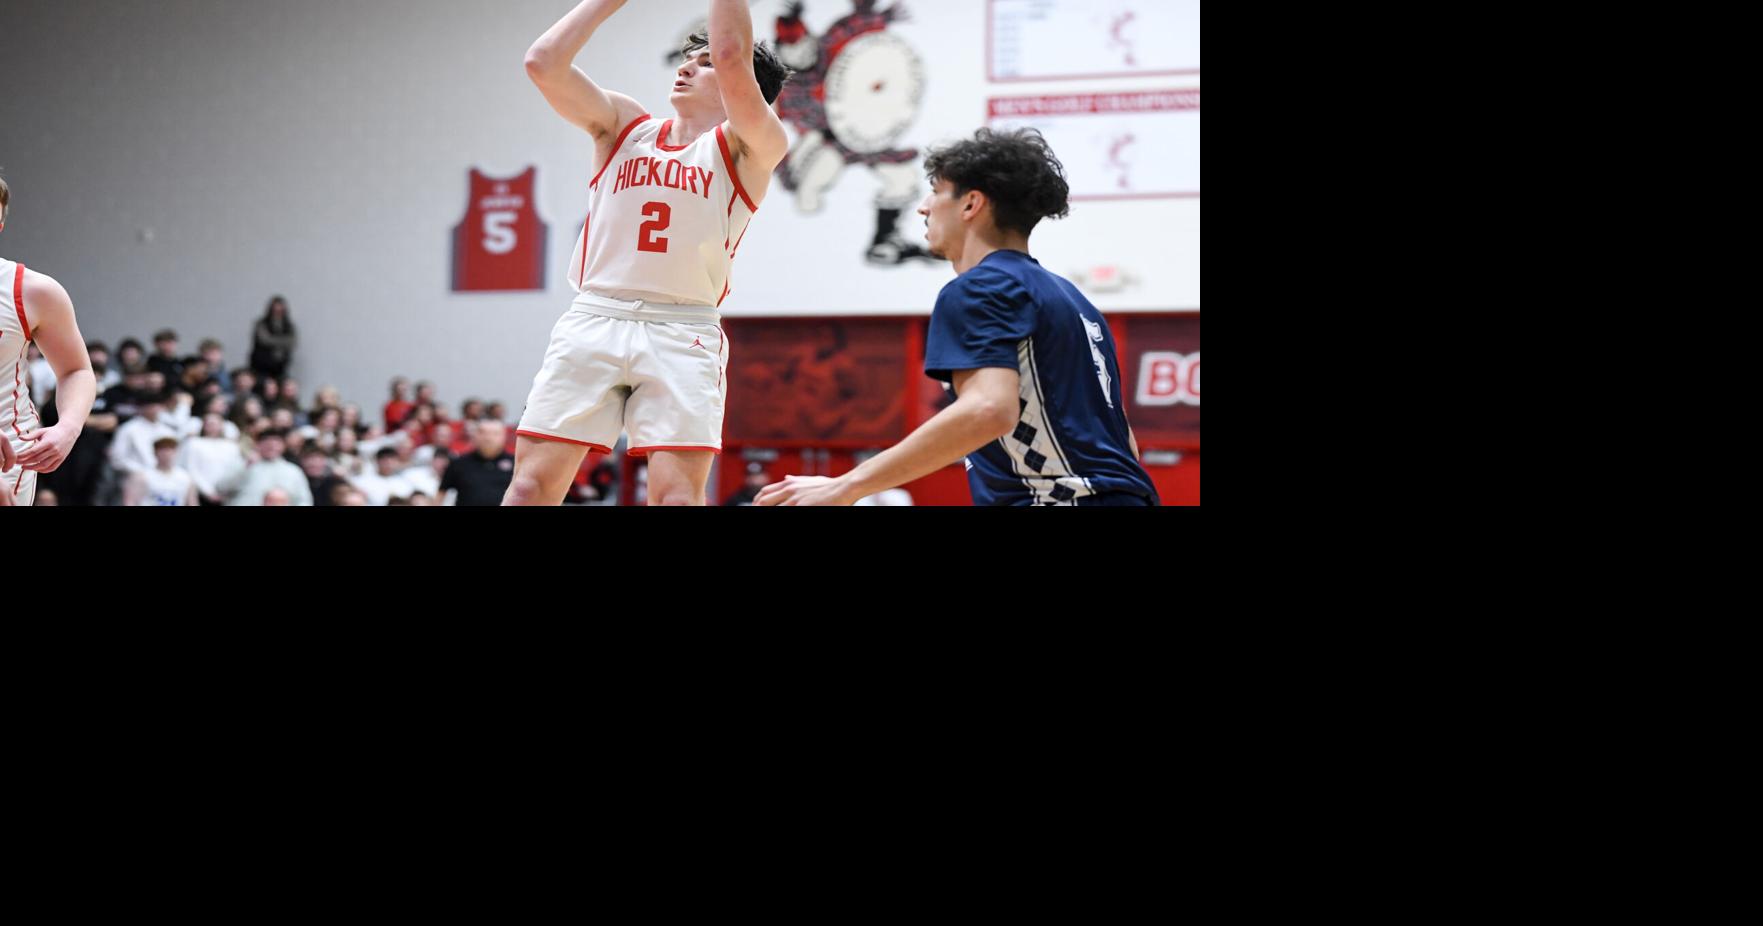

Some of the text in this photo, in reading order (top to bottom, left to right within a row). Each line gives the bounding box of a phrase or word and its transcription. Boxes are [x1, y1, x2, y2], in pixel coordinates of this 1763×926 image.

[613, 157, 714, 200] HICKORY
[483, 211, 518, 255] 5
[637, 201, 671, 253] 2
